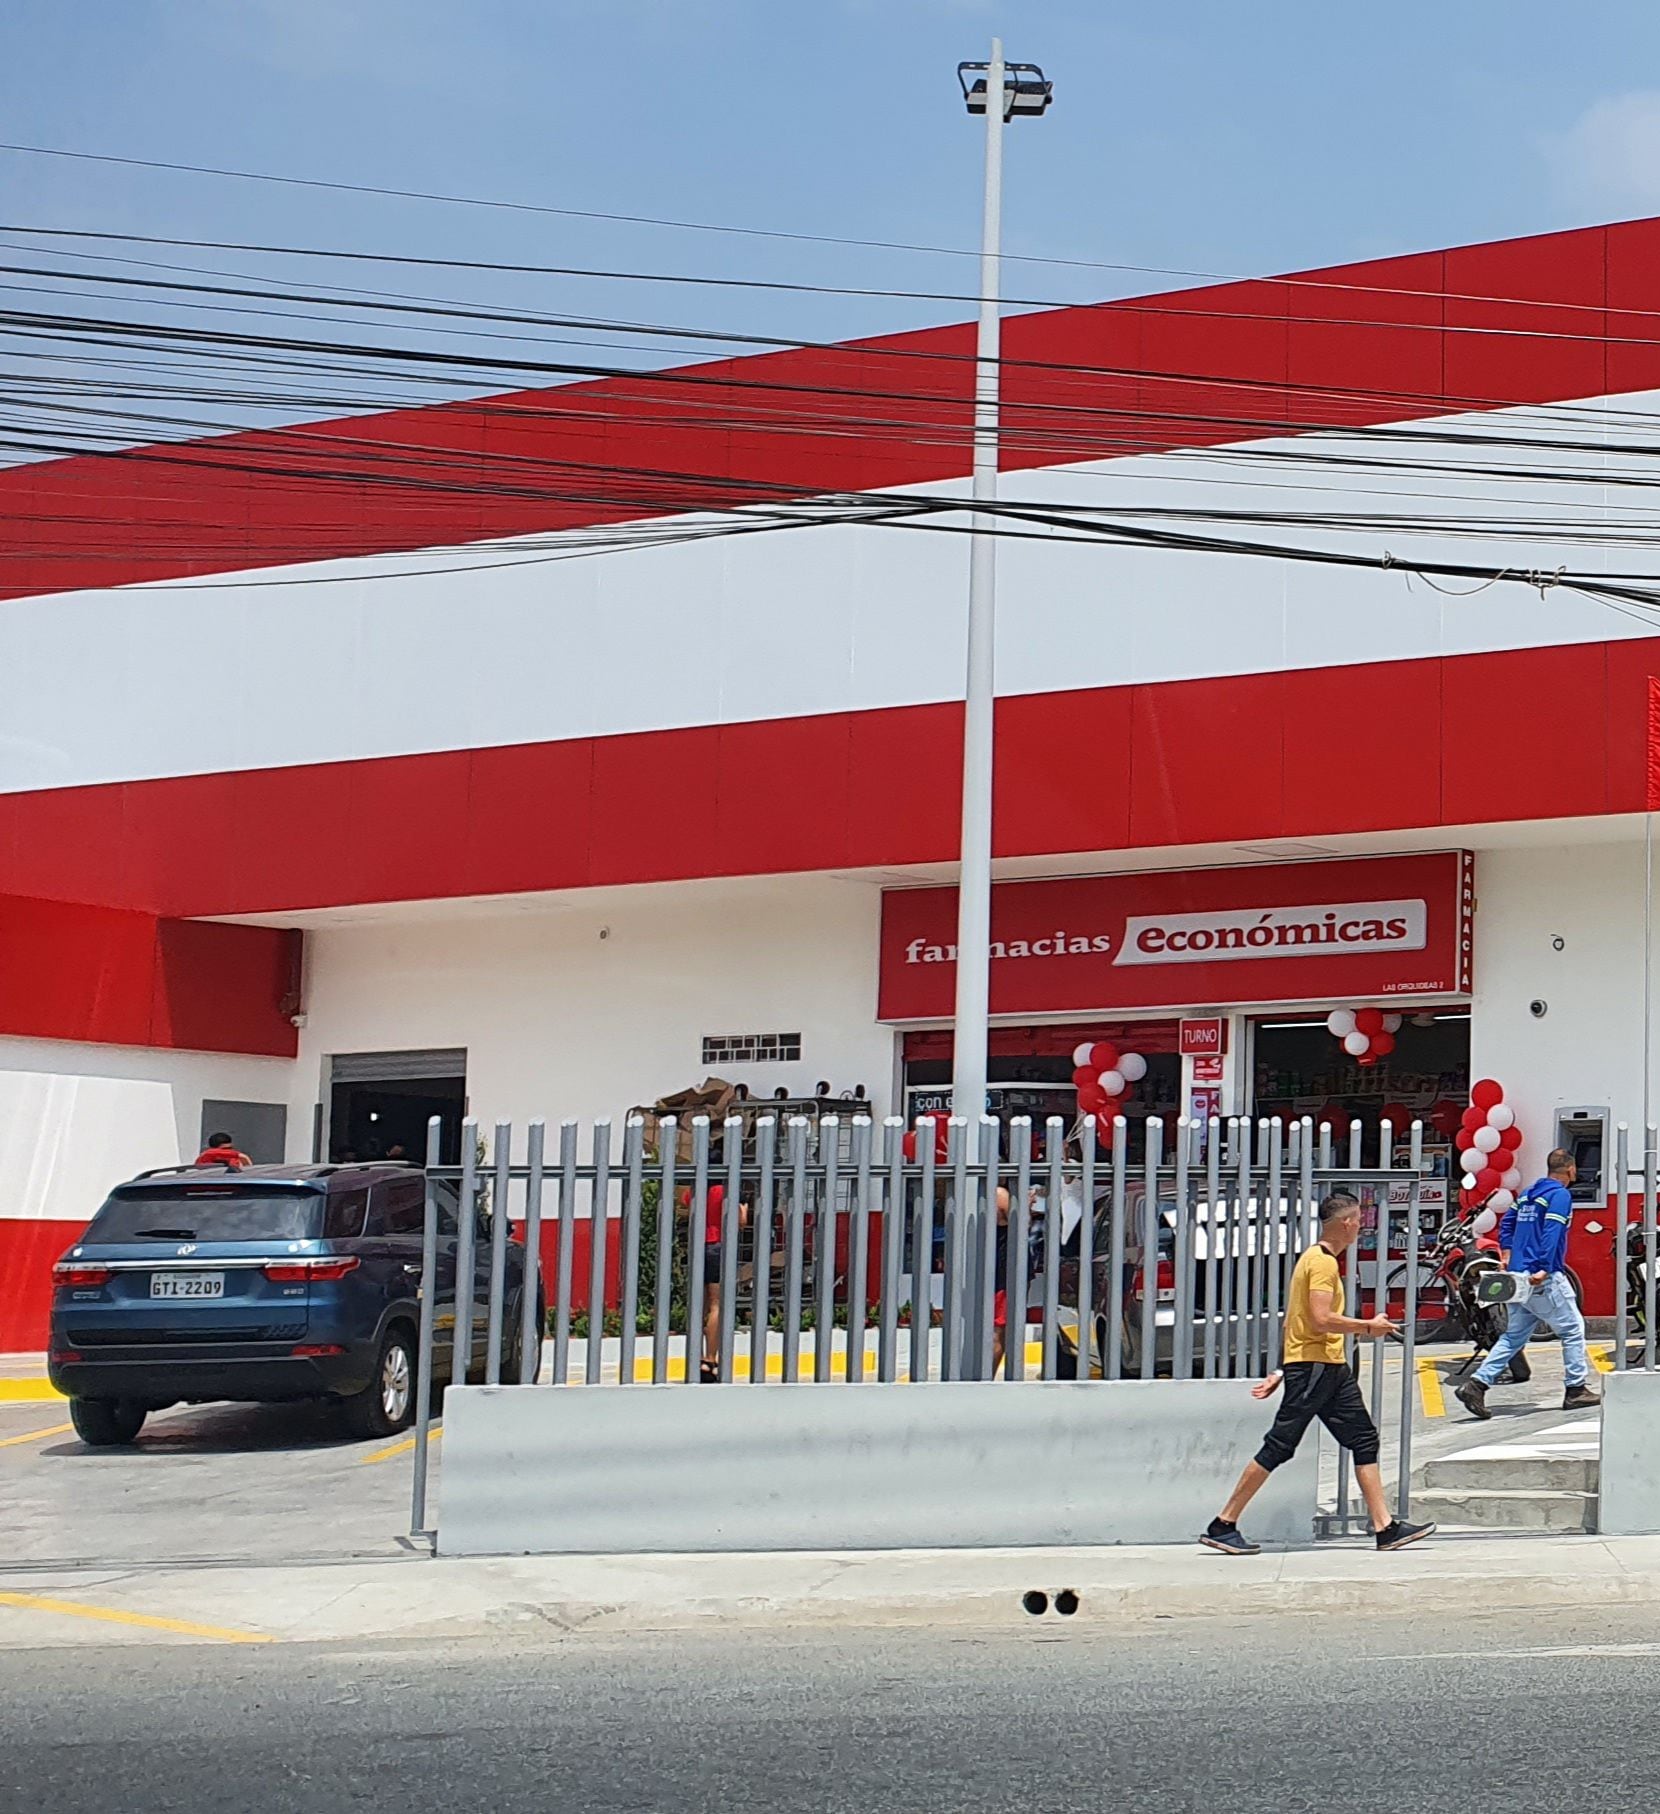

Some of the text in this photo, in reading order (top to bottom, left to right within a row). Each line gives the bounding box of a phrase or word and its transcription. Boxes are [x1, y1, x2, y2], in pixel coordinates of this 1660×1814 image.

[1136, 913, 1408, 954] económicas
[1461, 855, 1473, 987] FARMACIA
[1184, 1028, 1218, 1044] TURNO
[152, 1280, 222, 1296] GTI-2209
